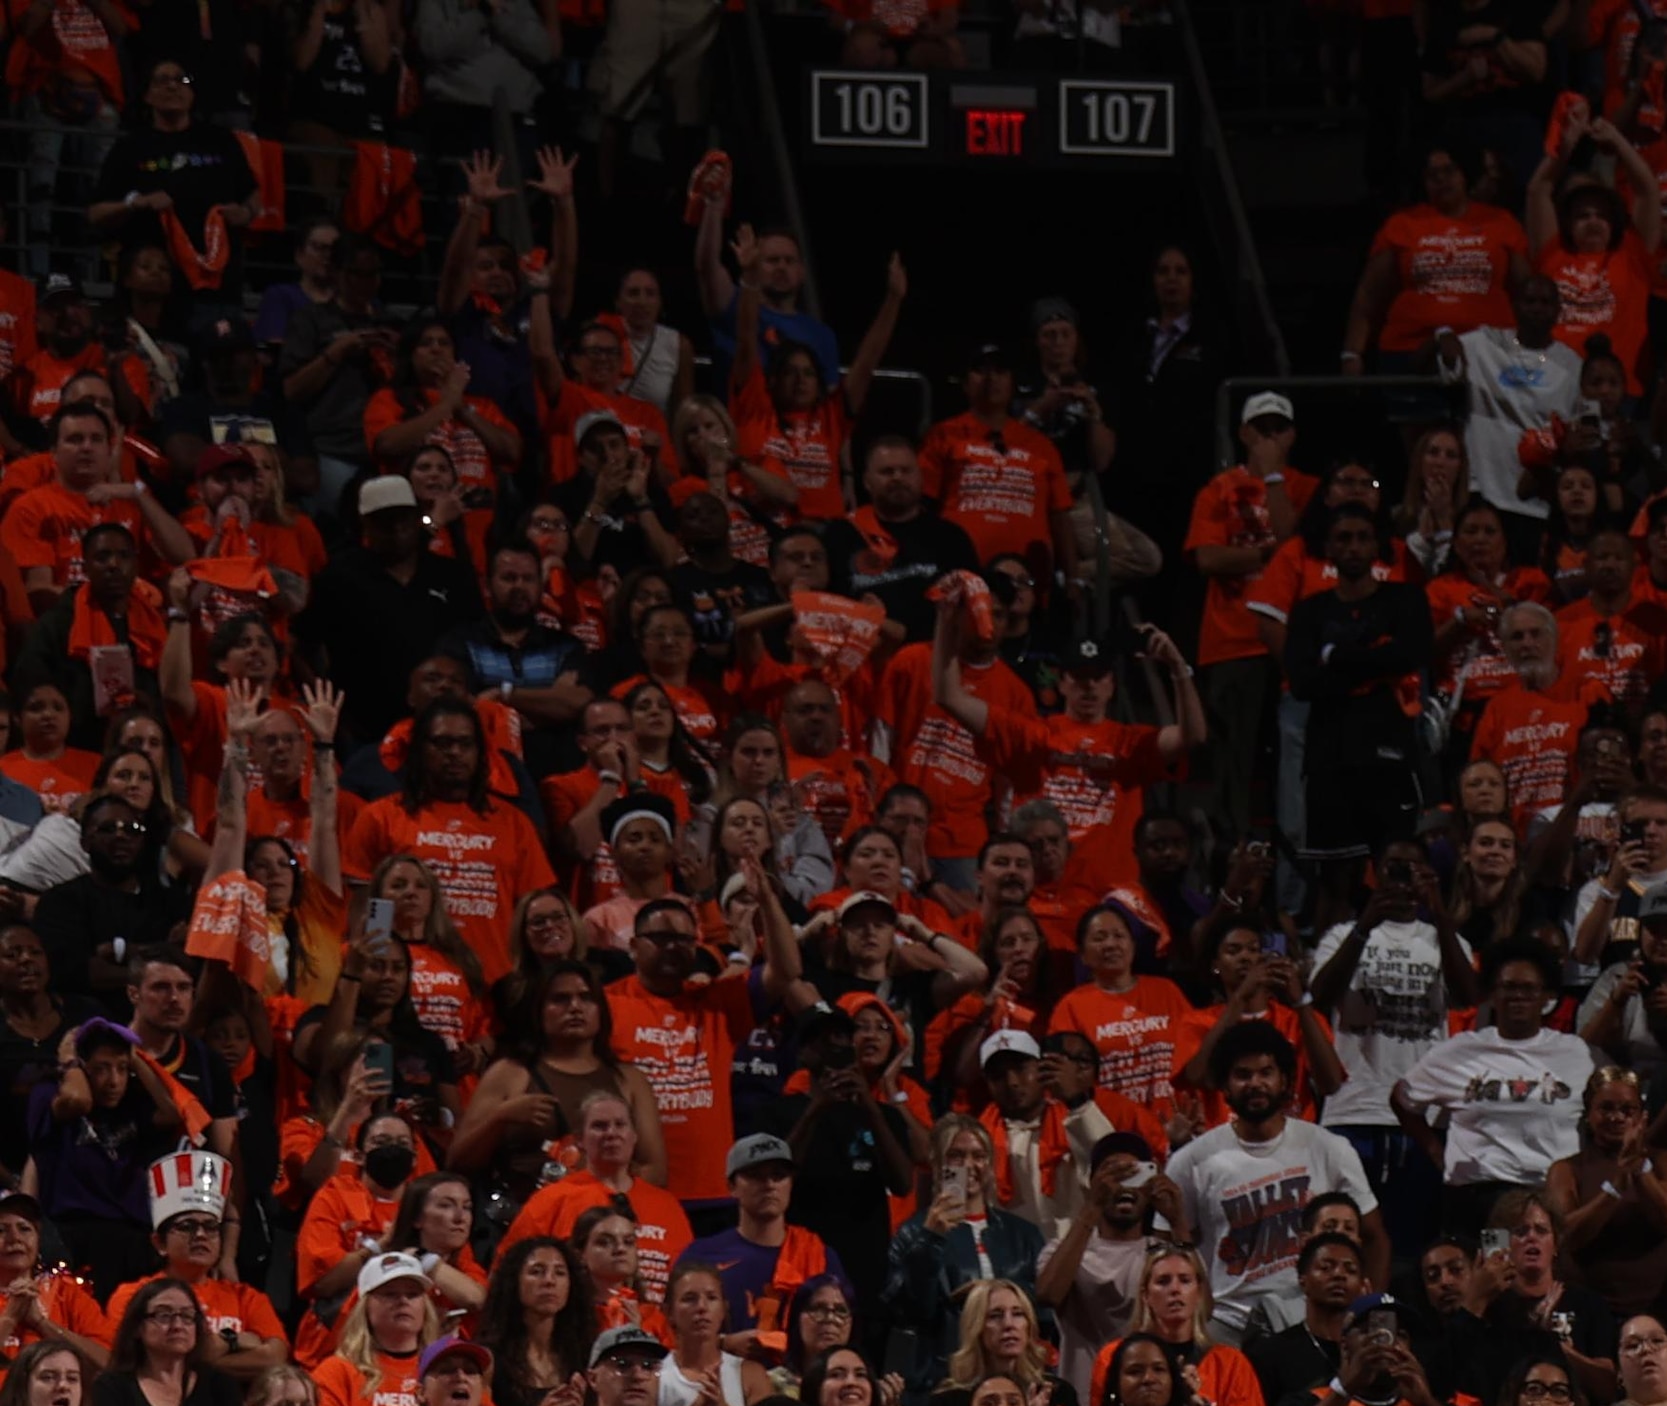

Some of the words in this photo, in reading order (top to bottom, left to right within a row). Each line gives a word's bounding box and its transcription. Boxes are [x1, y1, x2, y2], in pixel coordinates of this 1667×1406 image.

[835, 83, 913, 136] 106
[966, 108, 1028, 157] EXIT
[1081, 92, 1157, 144] 107
